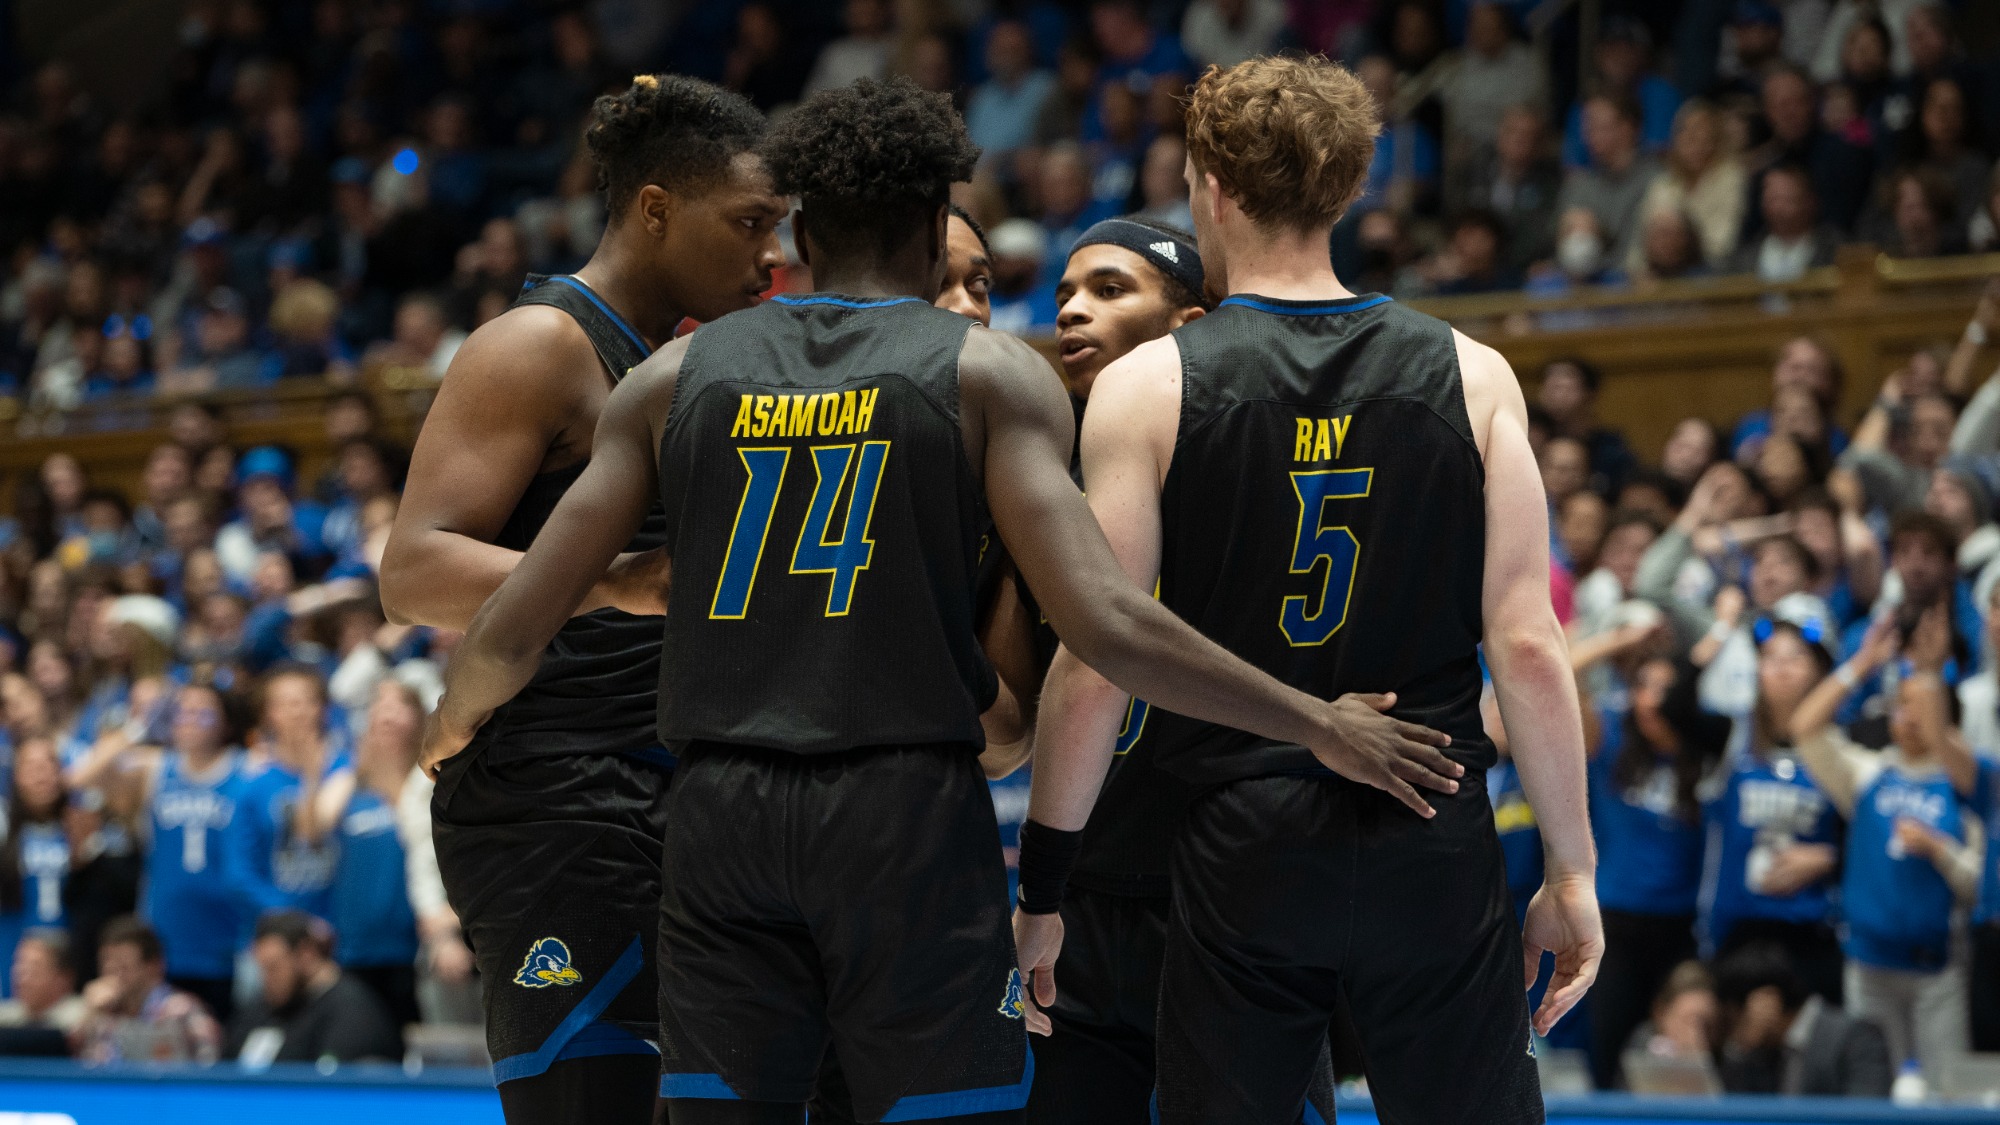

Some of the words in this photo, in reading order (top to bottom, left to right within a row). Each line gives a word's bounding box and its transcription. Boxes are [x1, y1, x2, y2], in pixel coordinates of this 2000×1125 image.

[1150, 243, 1179, 264] adidas
[730, 388, 879, 437] ASAMOAH
[1294, 415, 1352, 462] RAY
[708, 441, 891, 619] 14
[1278, 467, 1375, 648] 5
